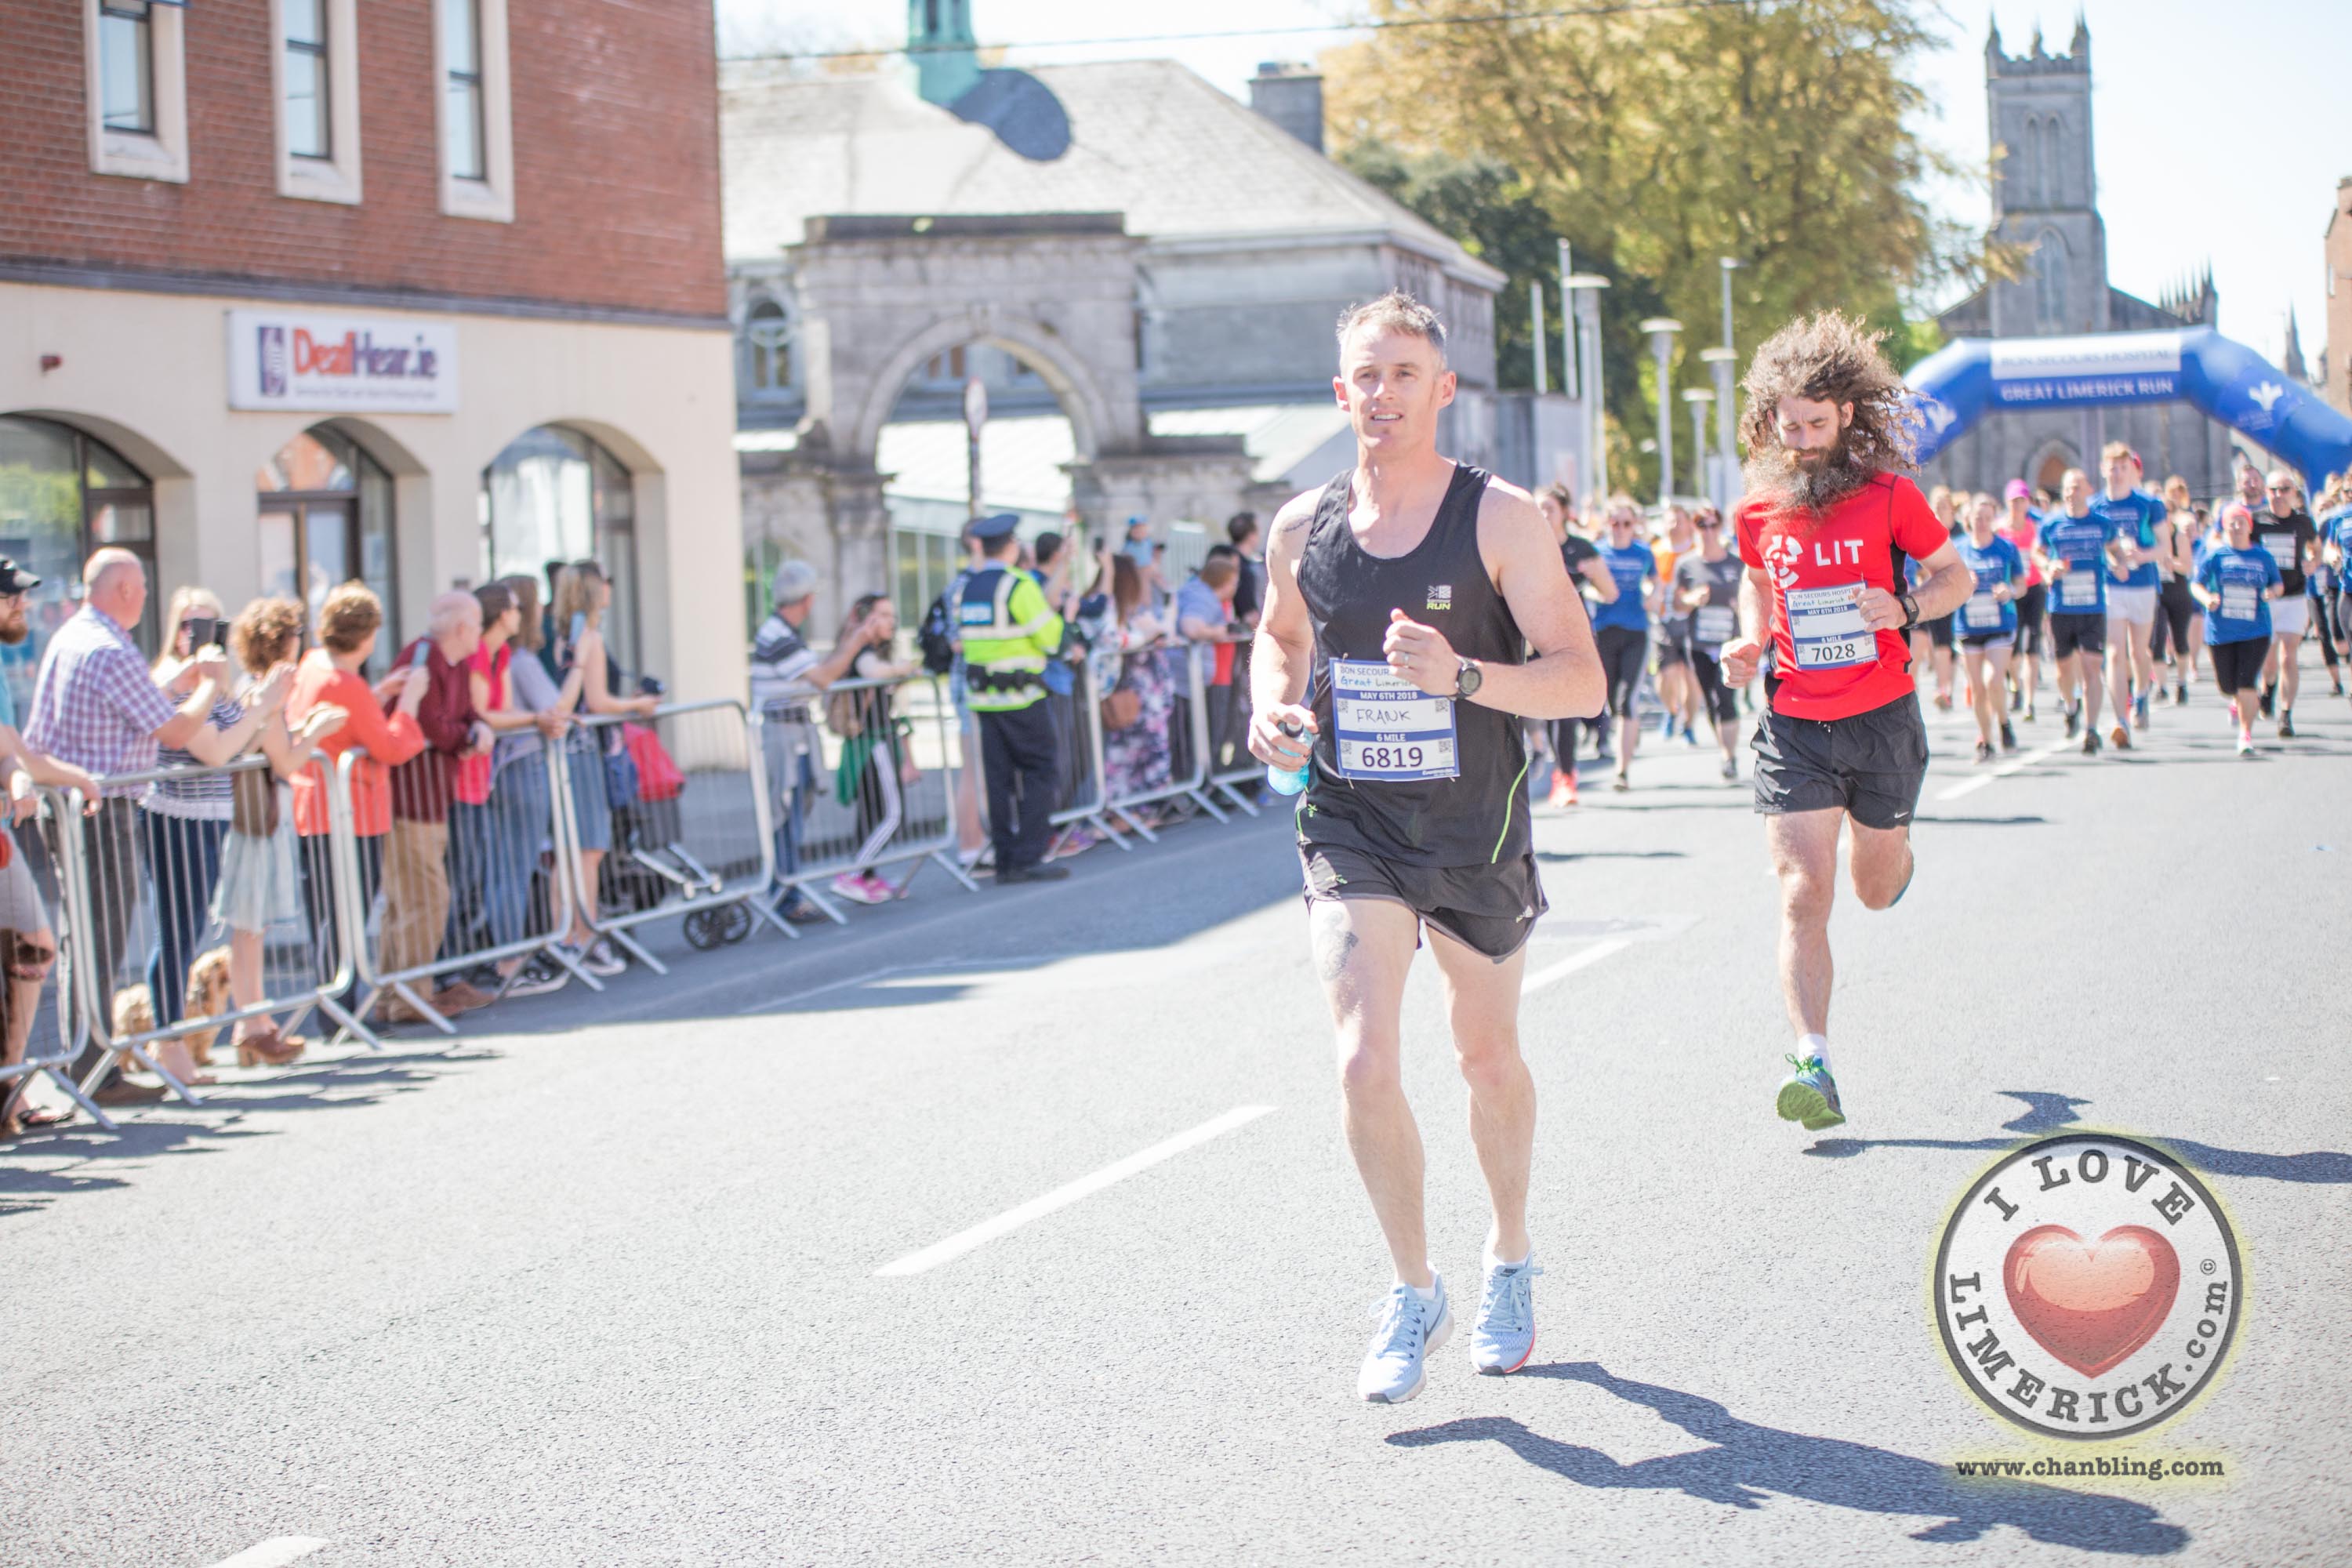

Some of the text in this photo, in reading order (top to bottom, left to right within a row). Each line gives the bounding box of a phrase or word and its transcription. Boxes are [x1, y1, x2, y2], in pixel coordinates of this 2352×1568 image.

[293, 327, 437, 378] DeafHear.ie
[2001, 376, 2174, 401] GREAT LIMERICK RUN
[1815, 539, 1864, 567] LIT
[1811, 644, 1856, 662] 7028
[1357, 666, 1390, 676] SECOUR
[1360, 691, 1417, 700] MAY 6TH 2018
[1356, 709, 1411, 724] FRANK
[1376, 733, 1406, 742] 6 MILE
[1362, 746, 1423, 768] 6819
